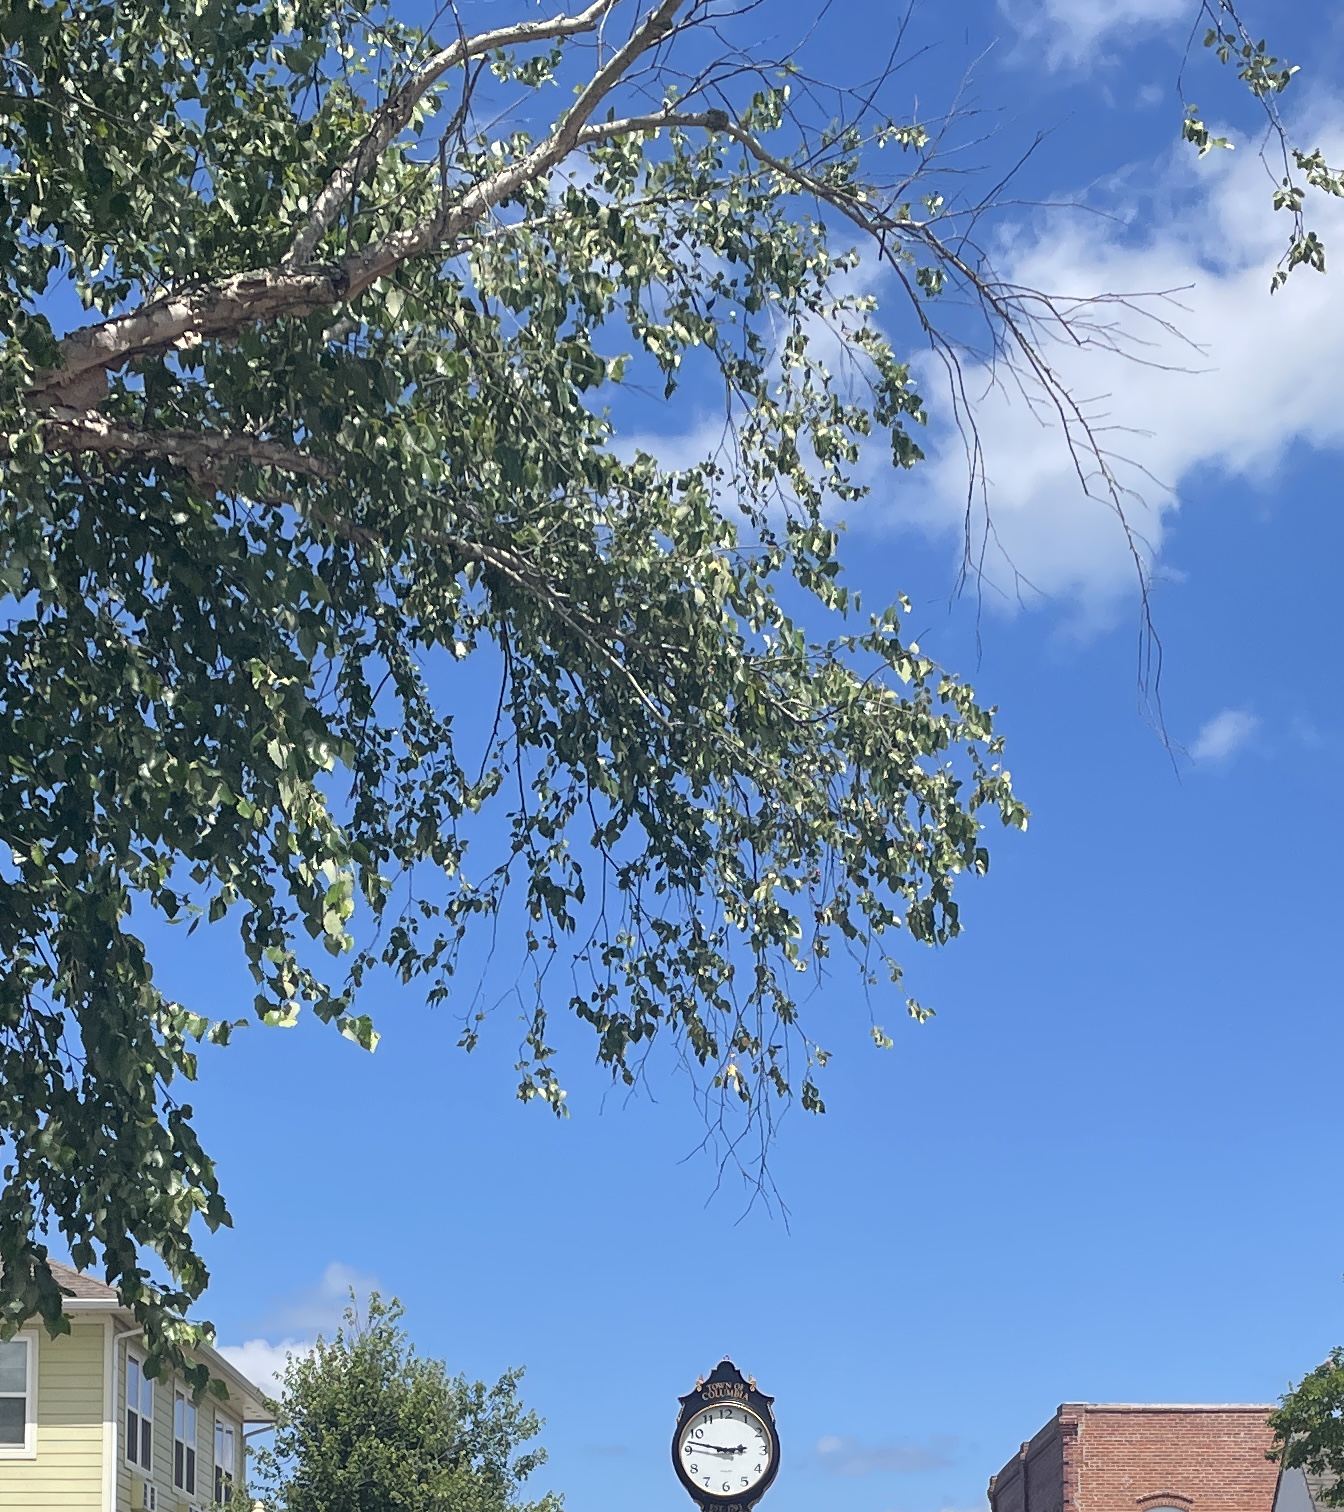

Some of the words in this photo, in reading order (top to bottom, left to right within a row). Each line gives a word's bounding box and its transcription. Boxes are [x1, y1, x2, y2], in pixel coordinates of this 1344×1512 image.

[706, 1382, 732, 1392] TOWN
[701, 1387, 749, 1401] COLUMBIA
[702, 1414, 713, 1425] 11
[719, 1409, 733, 1419] 12
[690, 1428, 704, 1439] 10
[754, 1427, 763, 1438] 2
[684, 1445, 693, 1456] 9
[759, 1445, 768, 1456] 3
[690, 1463, 698, 1474] 8
[754, 1463, 762, 1474] 4
[703, 1477, 710, 1488] 7
[722, 1481, 730, 1492] 6
[740, 1477, 749, 1487] 5
